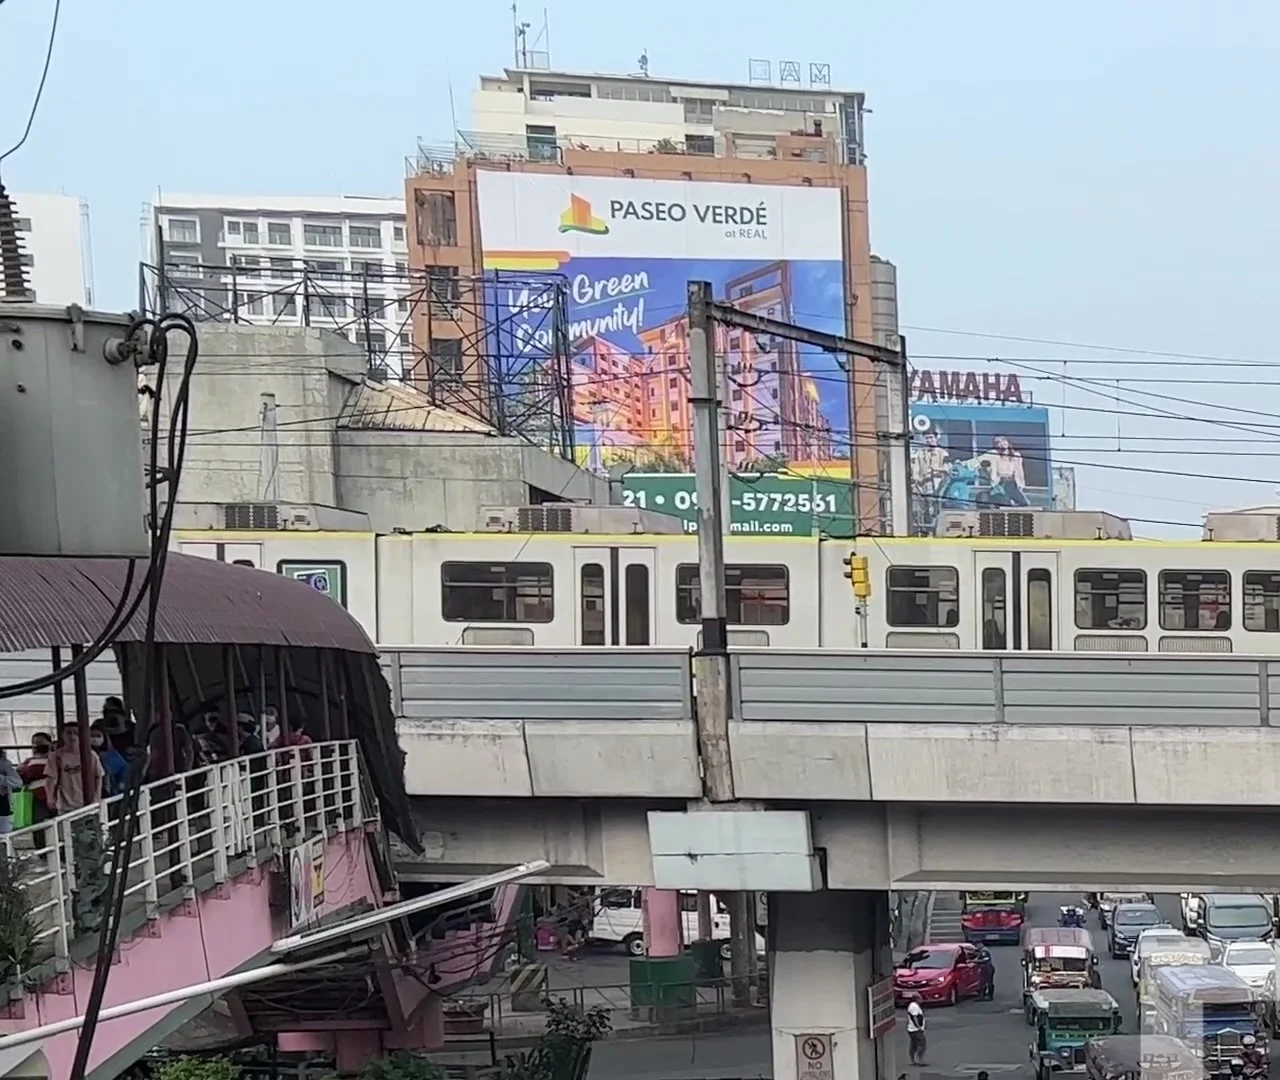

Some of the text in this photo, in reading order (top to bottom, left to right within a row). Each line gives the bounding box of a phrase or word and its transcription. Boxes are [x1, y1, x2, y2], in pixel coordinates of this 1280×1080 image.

[610, 200, 767, 226] PASEO VERDÉ
[739, 228, 767, 240] REAL
[573, 270, 649, 304] Green
[808, 1061, 823, 1070] NO
